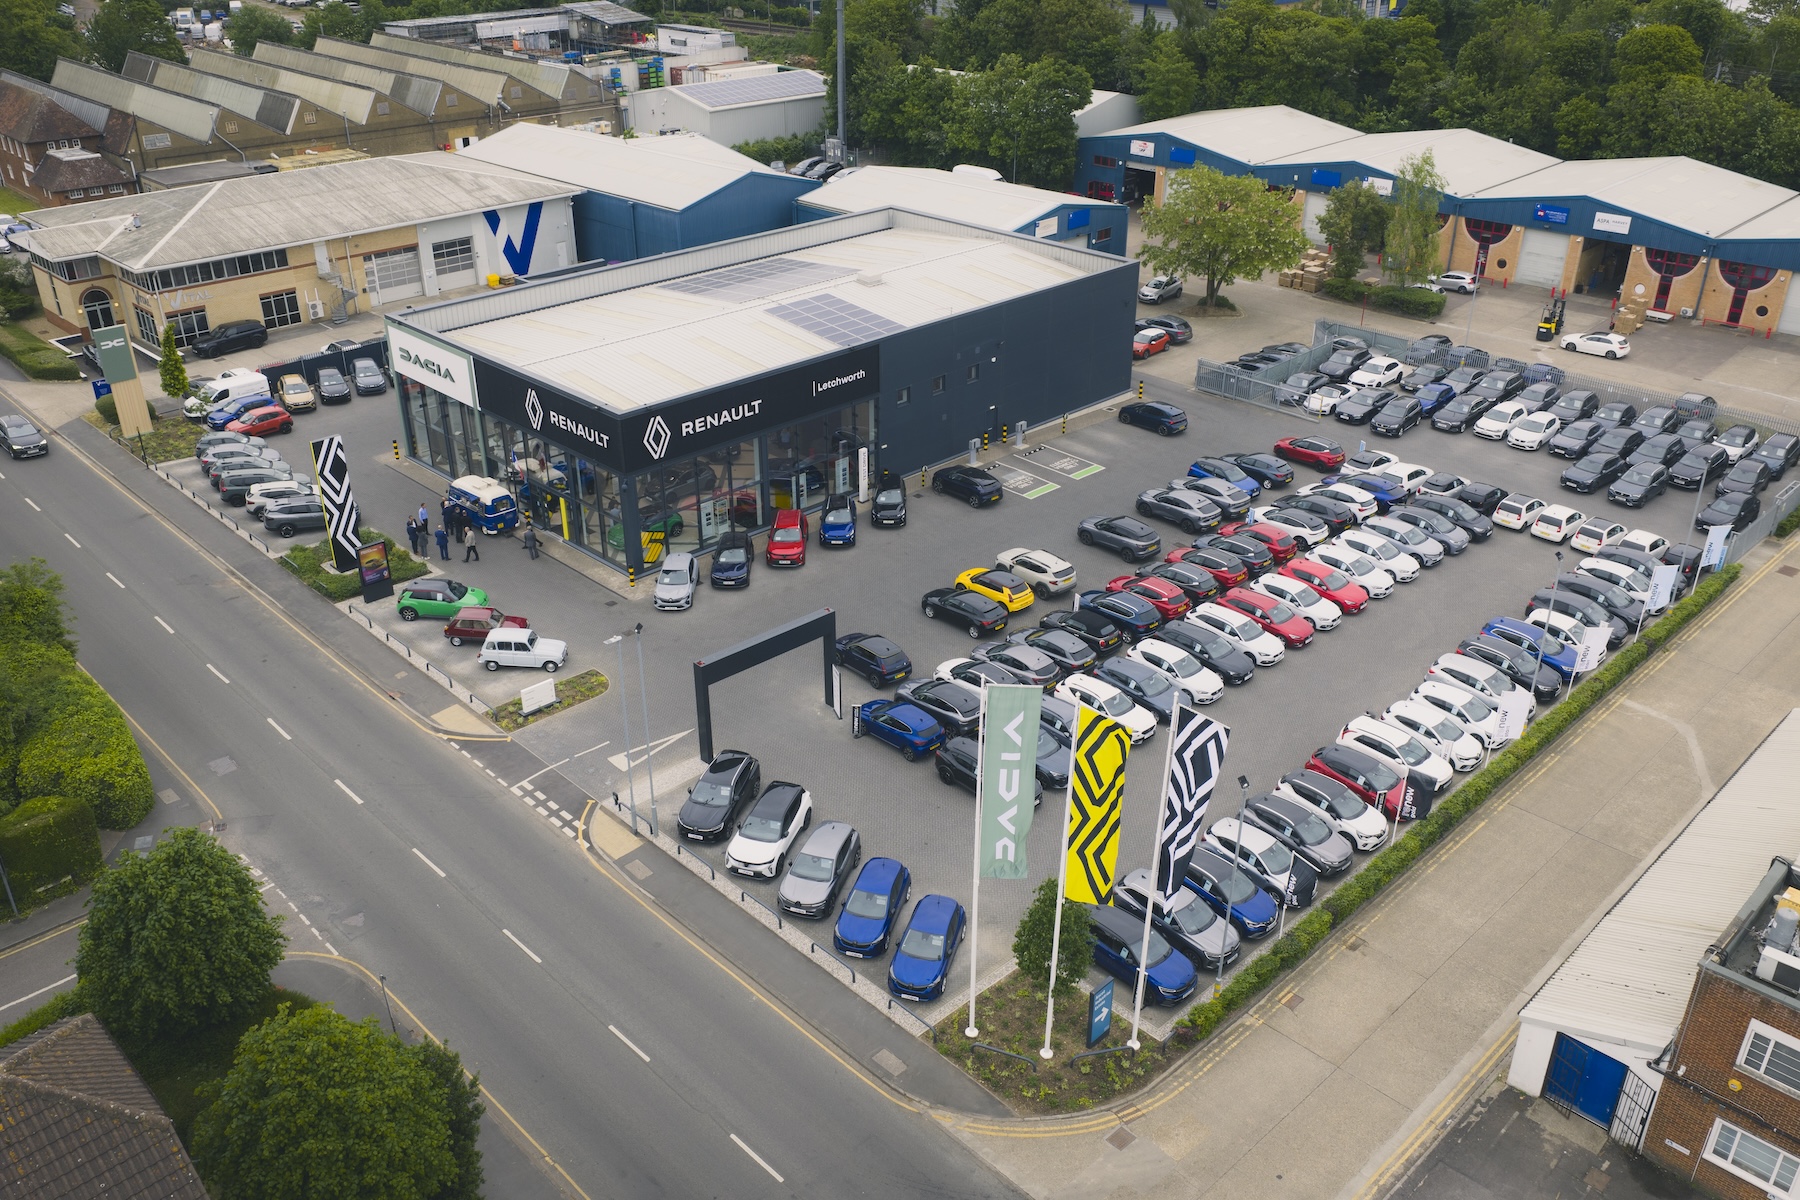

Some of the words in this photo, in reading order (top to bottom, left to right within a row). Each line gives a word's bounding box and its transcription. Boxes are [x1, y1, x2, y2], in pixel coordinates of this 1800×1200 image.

[398, 347, 456, 383] DACIA
[817, 369, 866, 392] Letchworth
[549, 410, 610, 449] RENAULT
[681, 399, 762, 437] RENAULT
[995, 710, 1024, 863] DACIA
